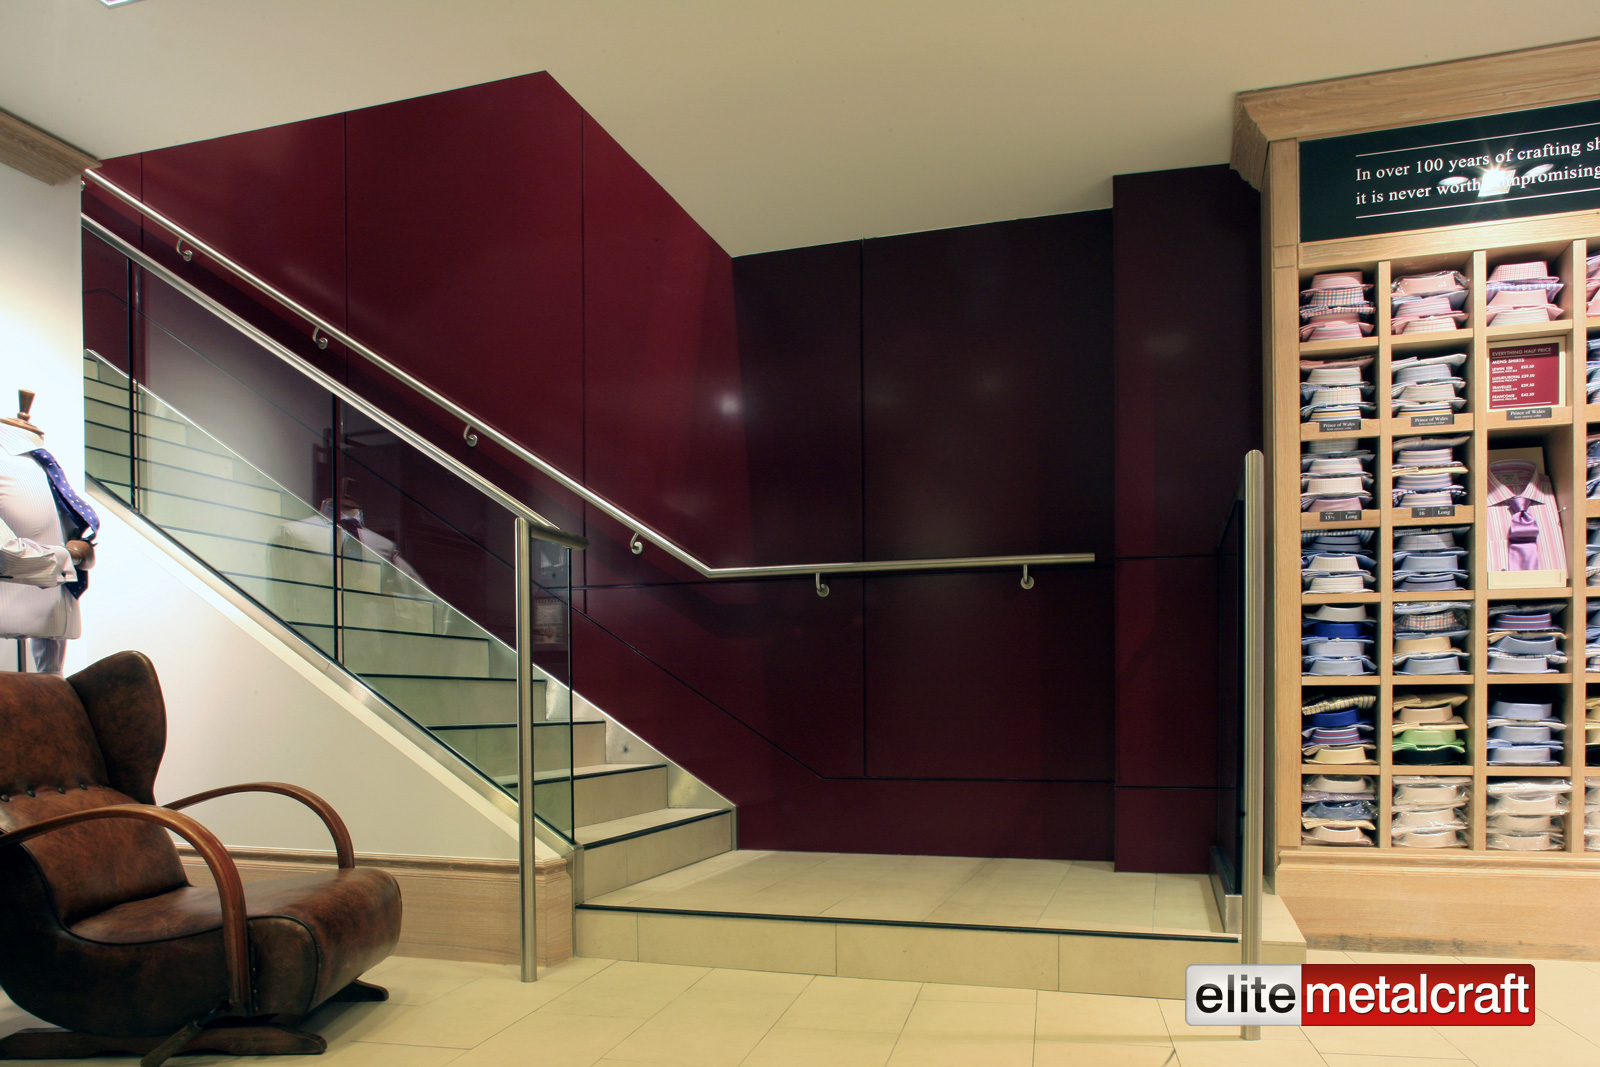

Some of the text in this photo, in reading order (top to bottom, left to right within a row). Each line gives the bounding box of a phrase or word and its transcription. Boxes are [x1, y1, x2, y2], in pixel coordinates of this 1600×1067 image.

[1356, 168, 1371, 181] In
[1376, 166, 1410, 180] over
[1416, 158, 1443, 174] 100
[1448, 154, 1490, 173] years
[1496, 148, 1514, 164] of
[1517, 142, 1581, 161] crafting
[1356, 164, 1600, 205] it is never worth ompromising
